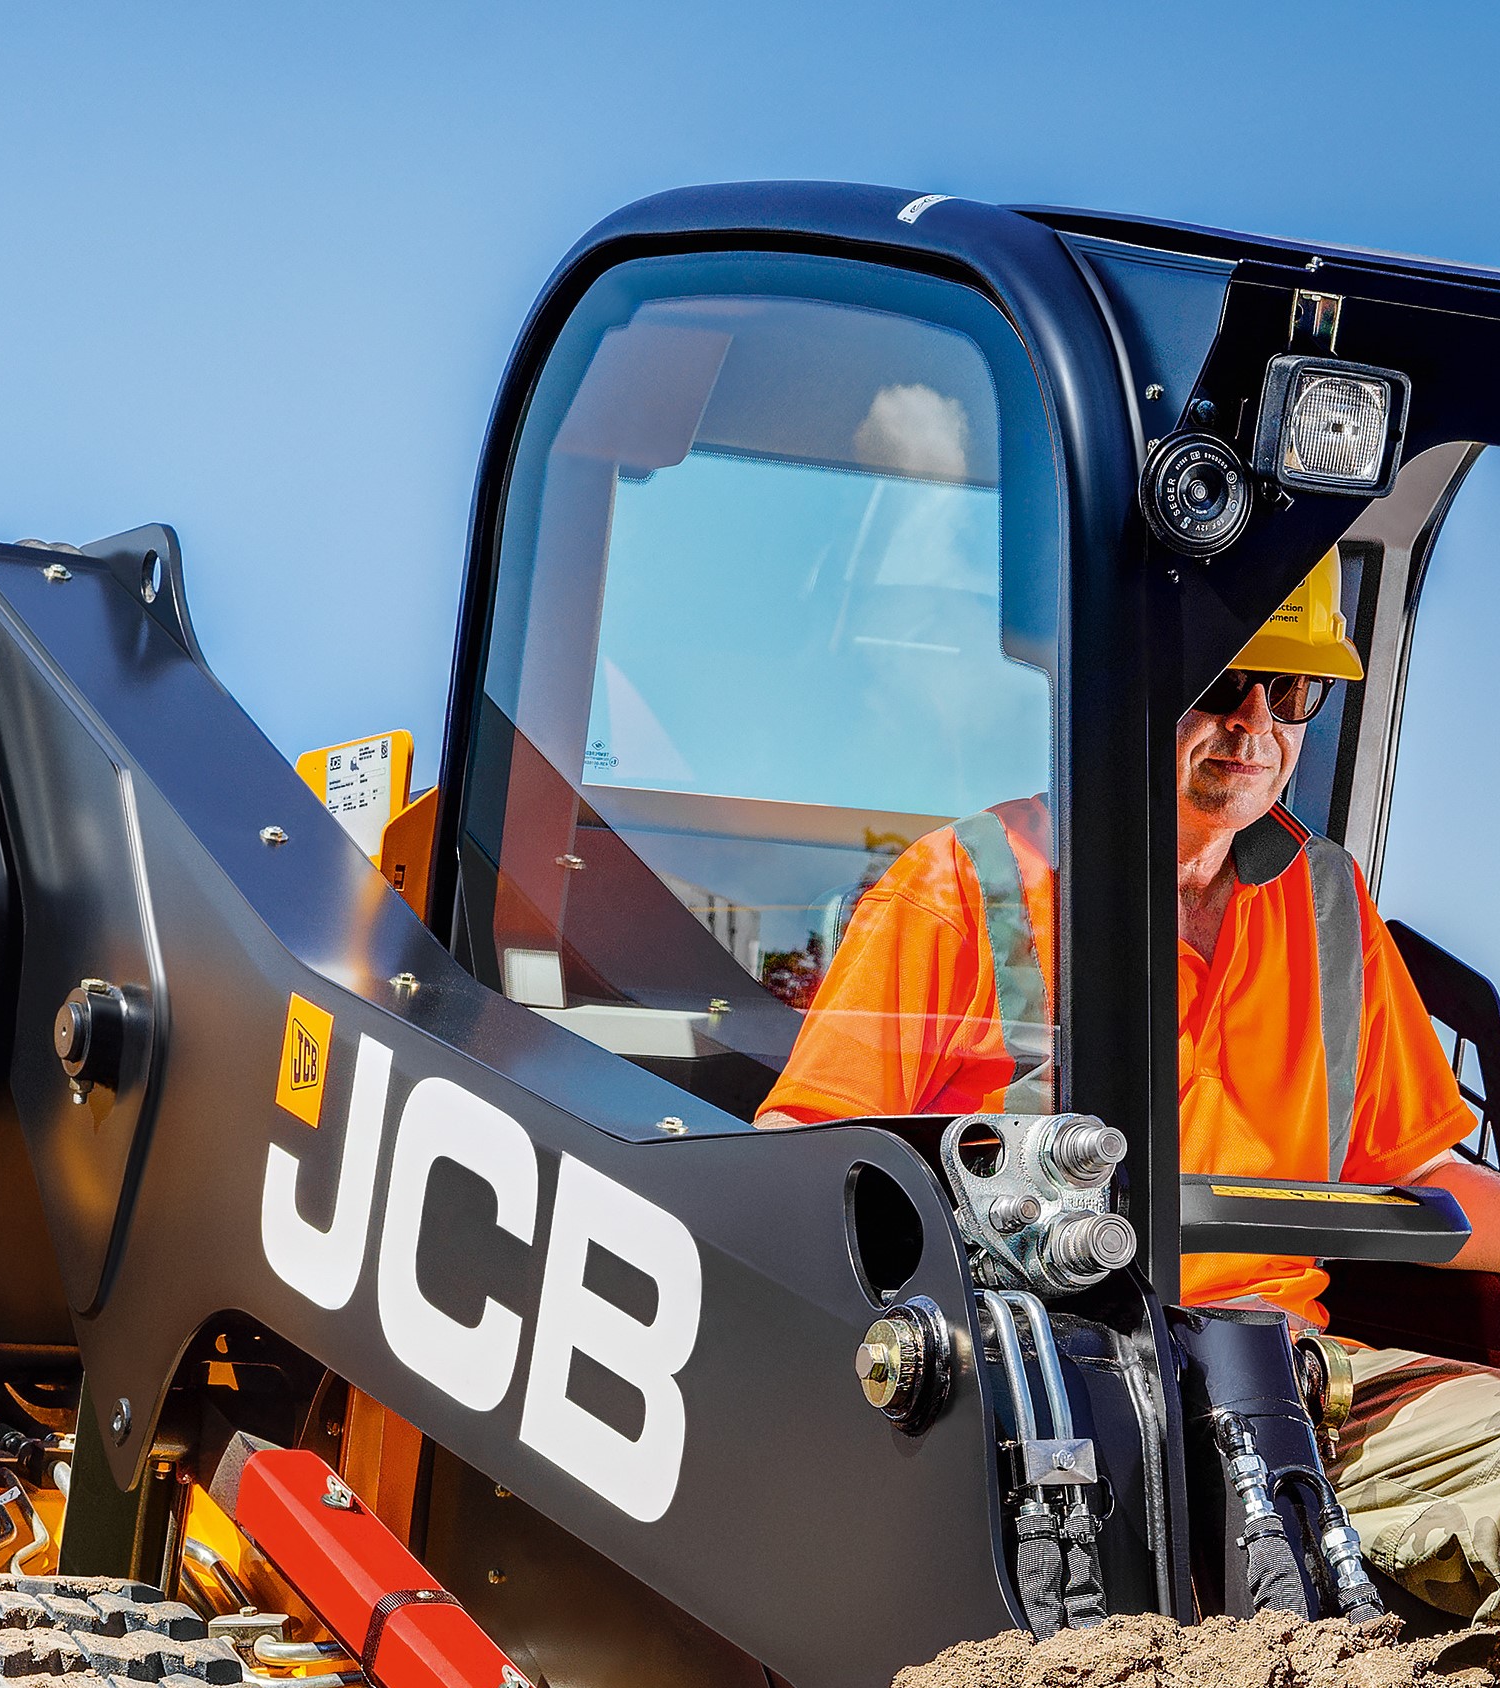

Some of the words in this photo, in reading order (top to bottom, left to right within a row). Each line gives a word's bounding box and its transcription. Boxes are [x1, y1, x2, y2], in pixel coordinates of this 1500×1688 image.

[1167, 478, 1181, 517] SEGER
[1269, 614, 1298, 623] pment
[1278, 603, 1303, 612] ction
[294, 1029, 317, 1083] JCB
[261, 1032, 702, 1523] JCB
